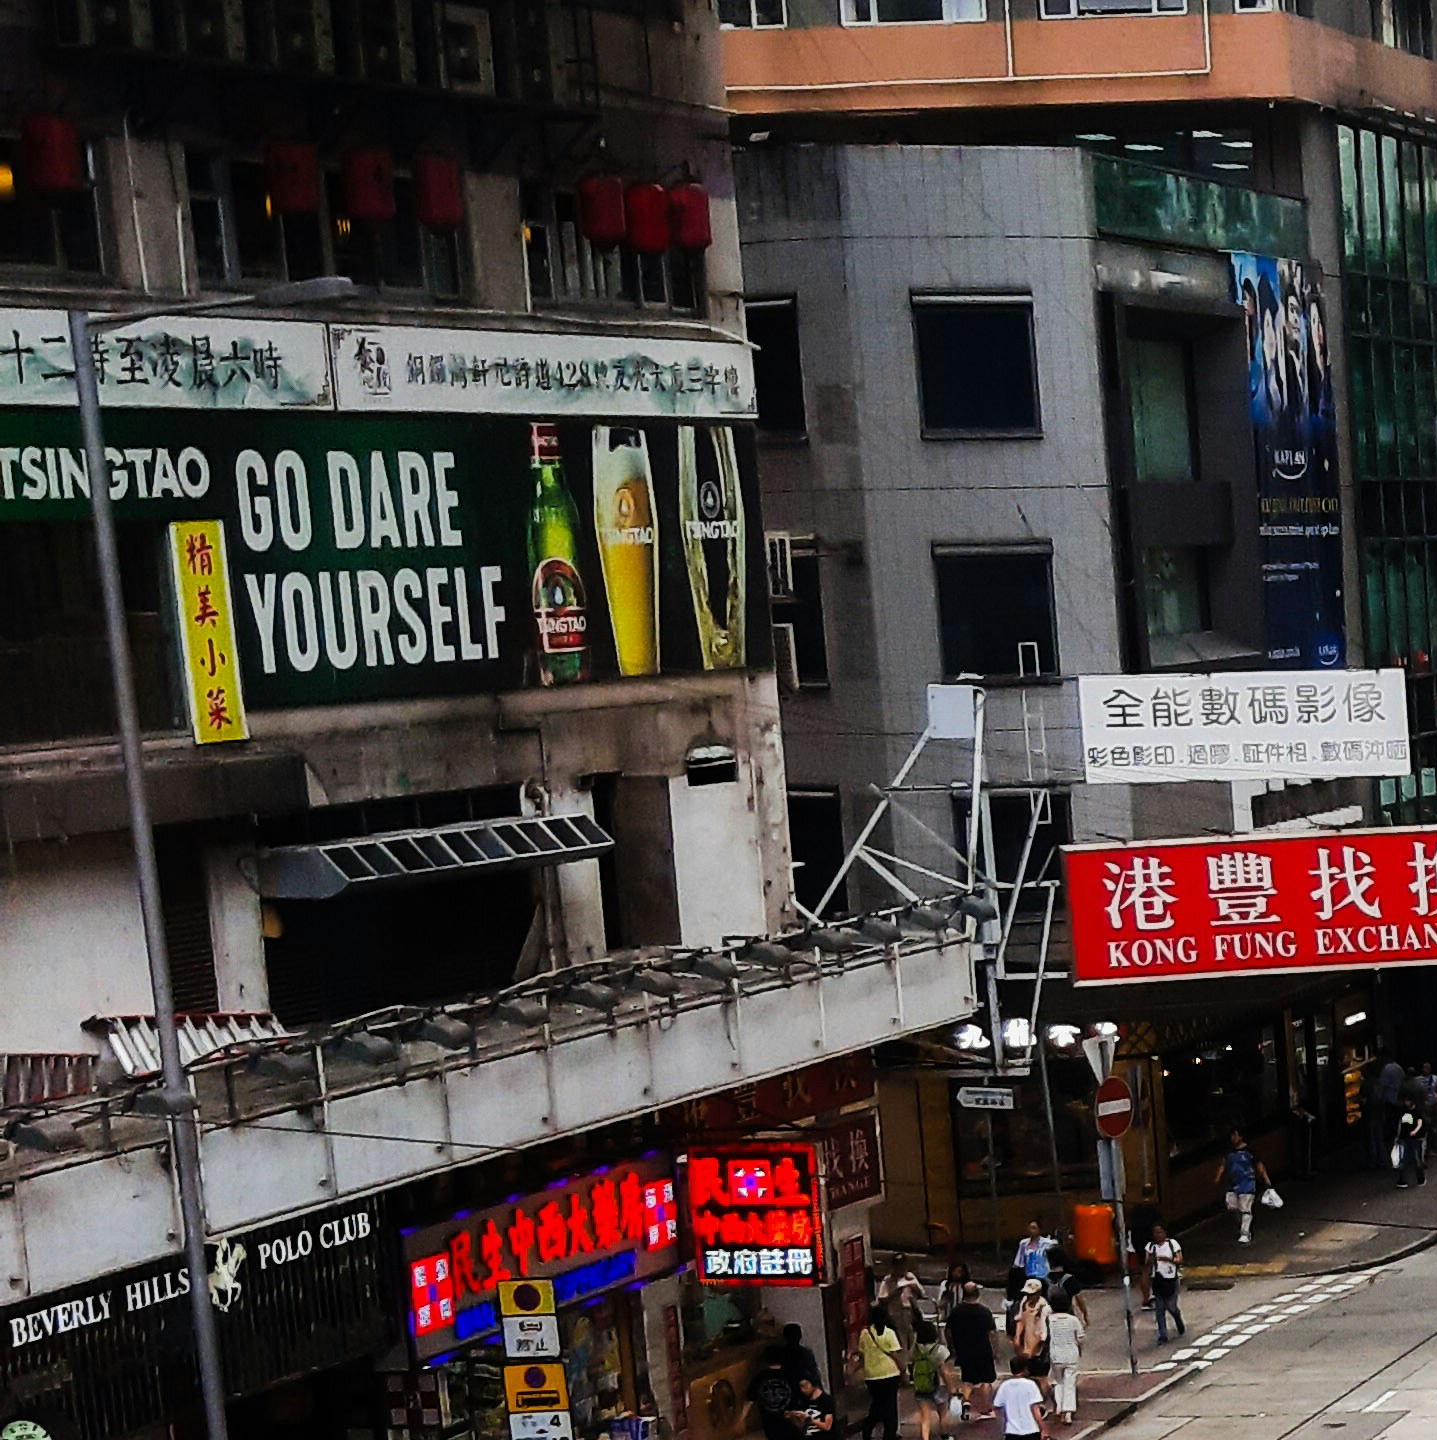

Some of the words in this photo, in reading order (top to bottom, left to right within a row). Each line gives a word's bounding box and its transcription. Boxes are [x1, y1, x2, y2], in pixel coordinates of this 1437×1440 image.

[0, 445, 211, 500] TSINGTAO
[236, 449, 311, 551] GO
[328, 451, 463, 549] DARE
[185, 534, 233, 731] 精美小菜
[244, 565, 503, 674] YOURSELF
[1103, 682, 1387, 729] 全能數碼影像
[1107, 936, 1198, 969] KONG
[1214, 932, 1298, 961] FUNG
[259, 1231, 312, 1269] POLO
[320, 1212, 371, 1248] CLUB
[705, 1248, 813, 1276] 政府註冊
[9, 1290, 112, 1347] BEVERLY
[126, 1268, 190, 1311] HILLS
